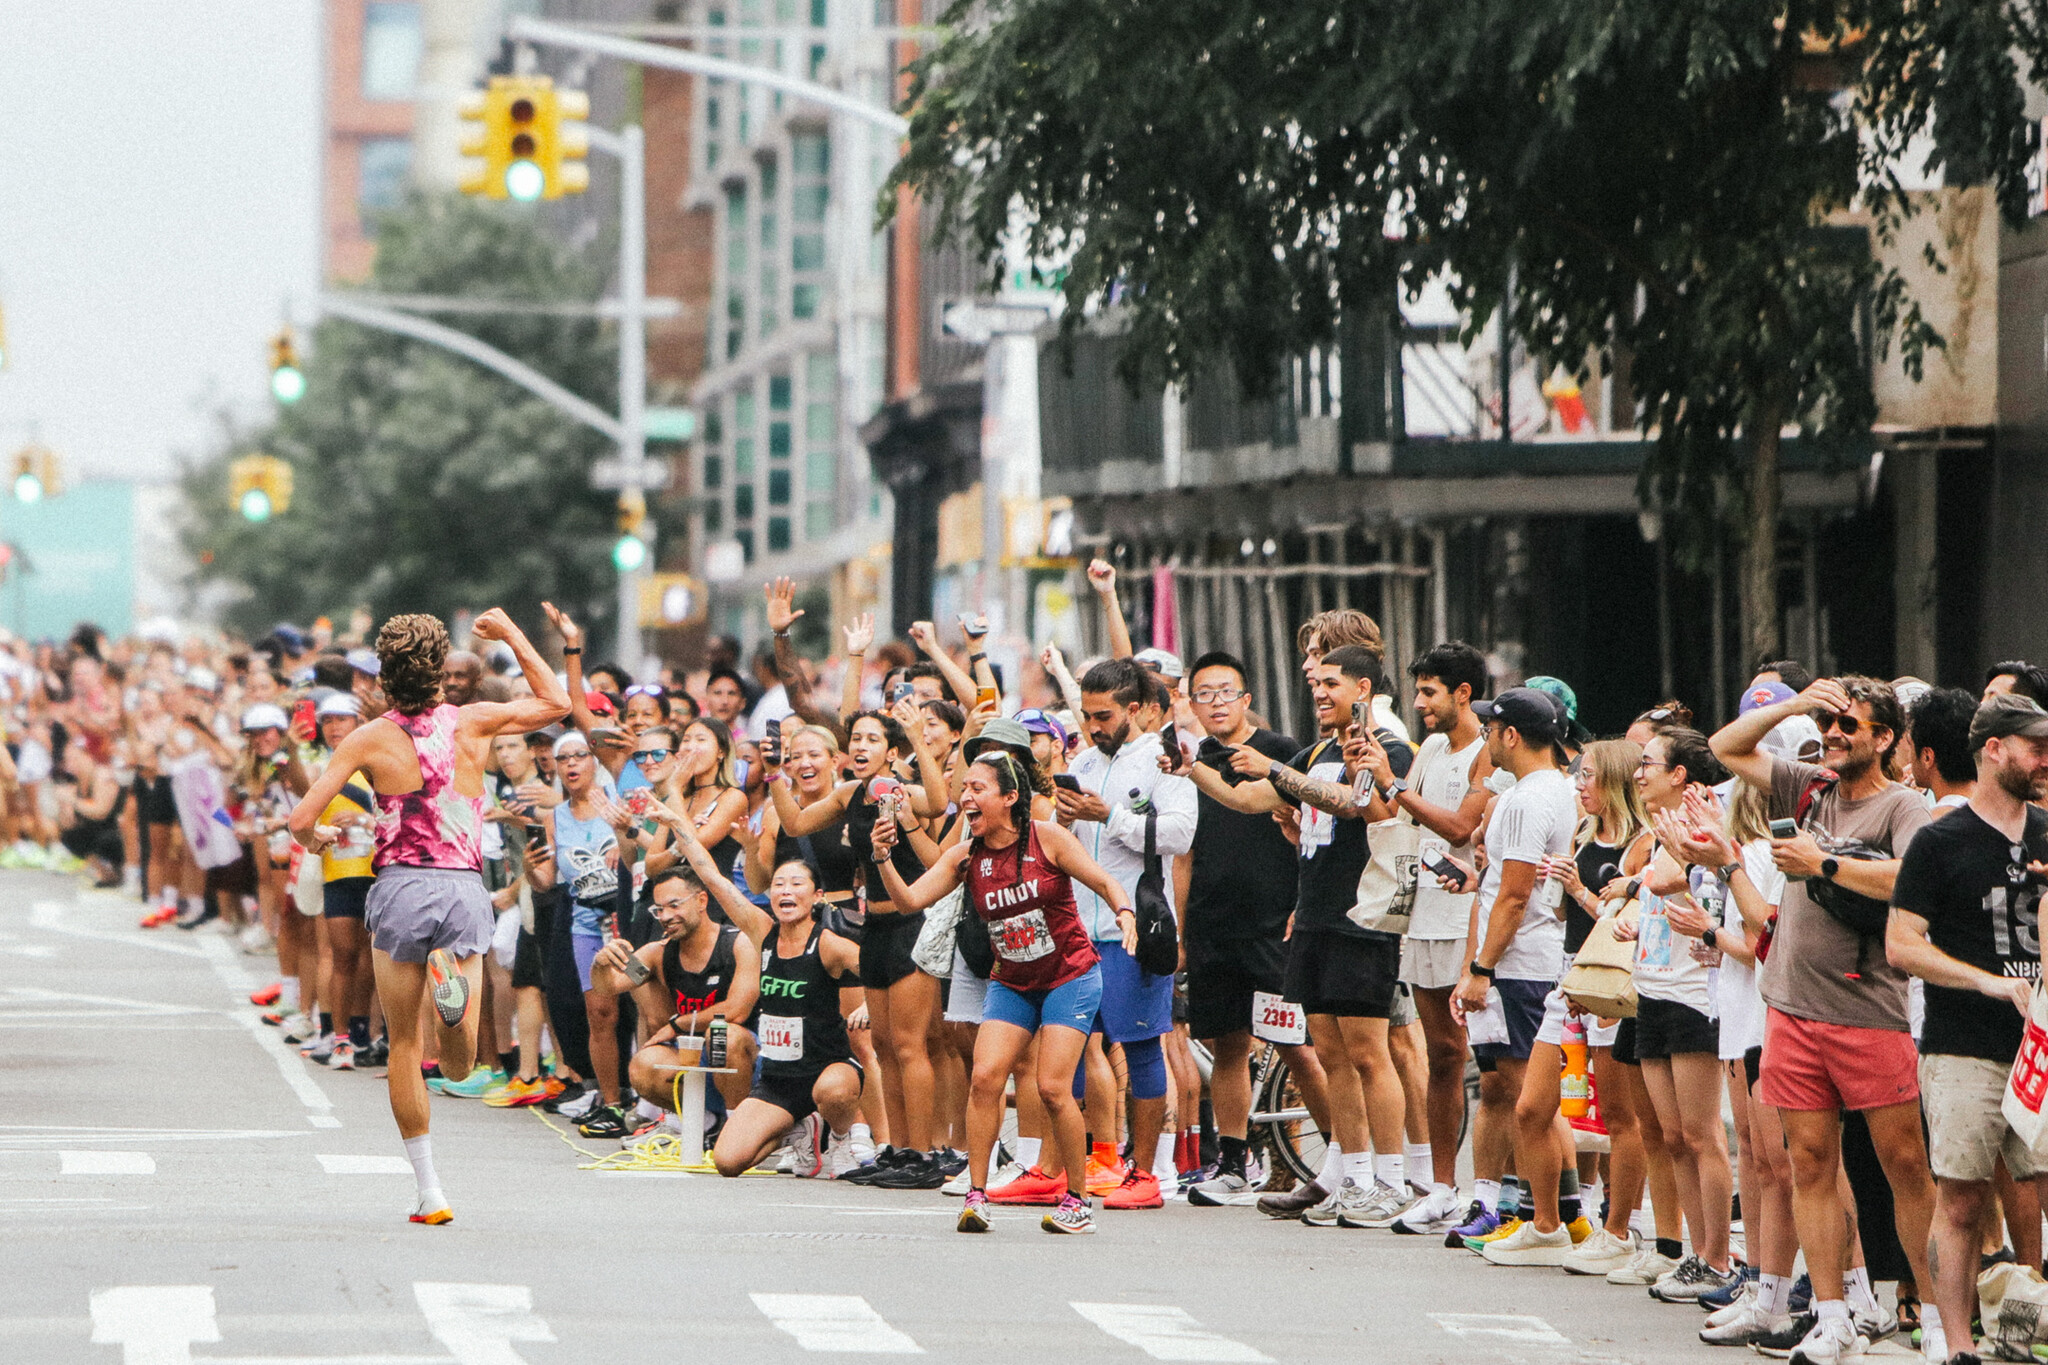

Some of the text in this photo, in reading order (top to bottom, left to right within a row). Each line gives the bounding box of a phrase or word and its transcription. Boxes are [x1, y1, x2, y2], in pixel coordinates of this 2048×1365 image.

[985, 879, 1039, 911] CINDY
[761, 975, 808, 998] GFTC
[1263, 1007, 1296, 1028] 2393
[766, 1029, 792, 1047] 1114
